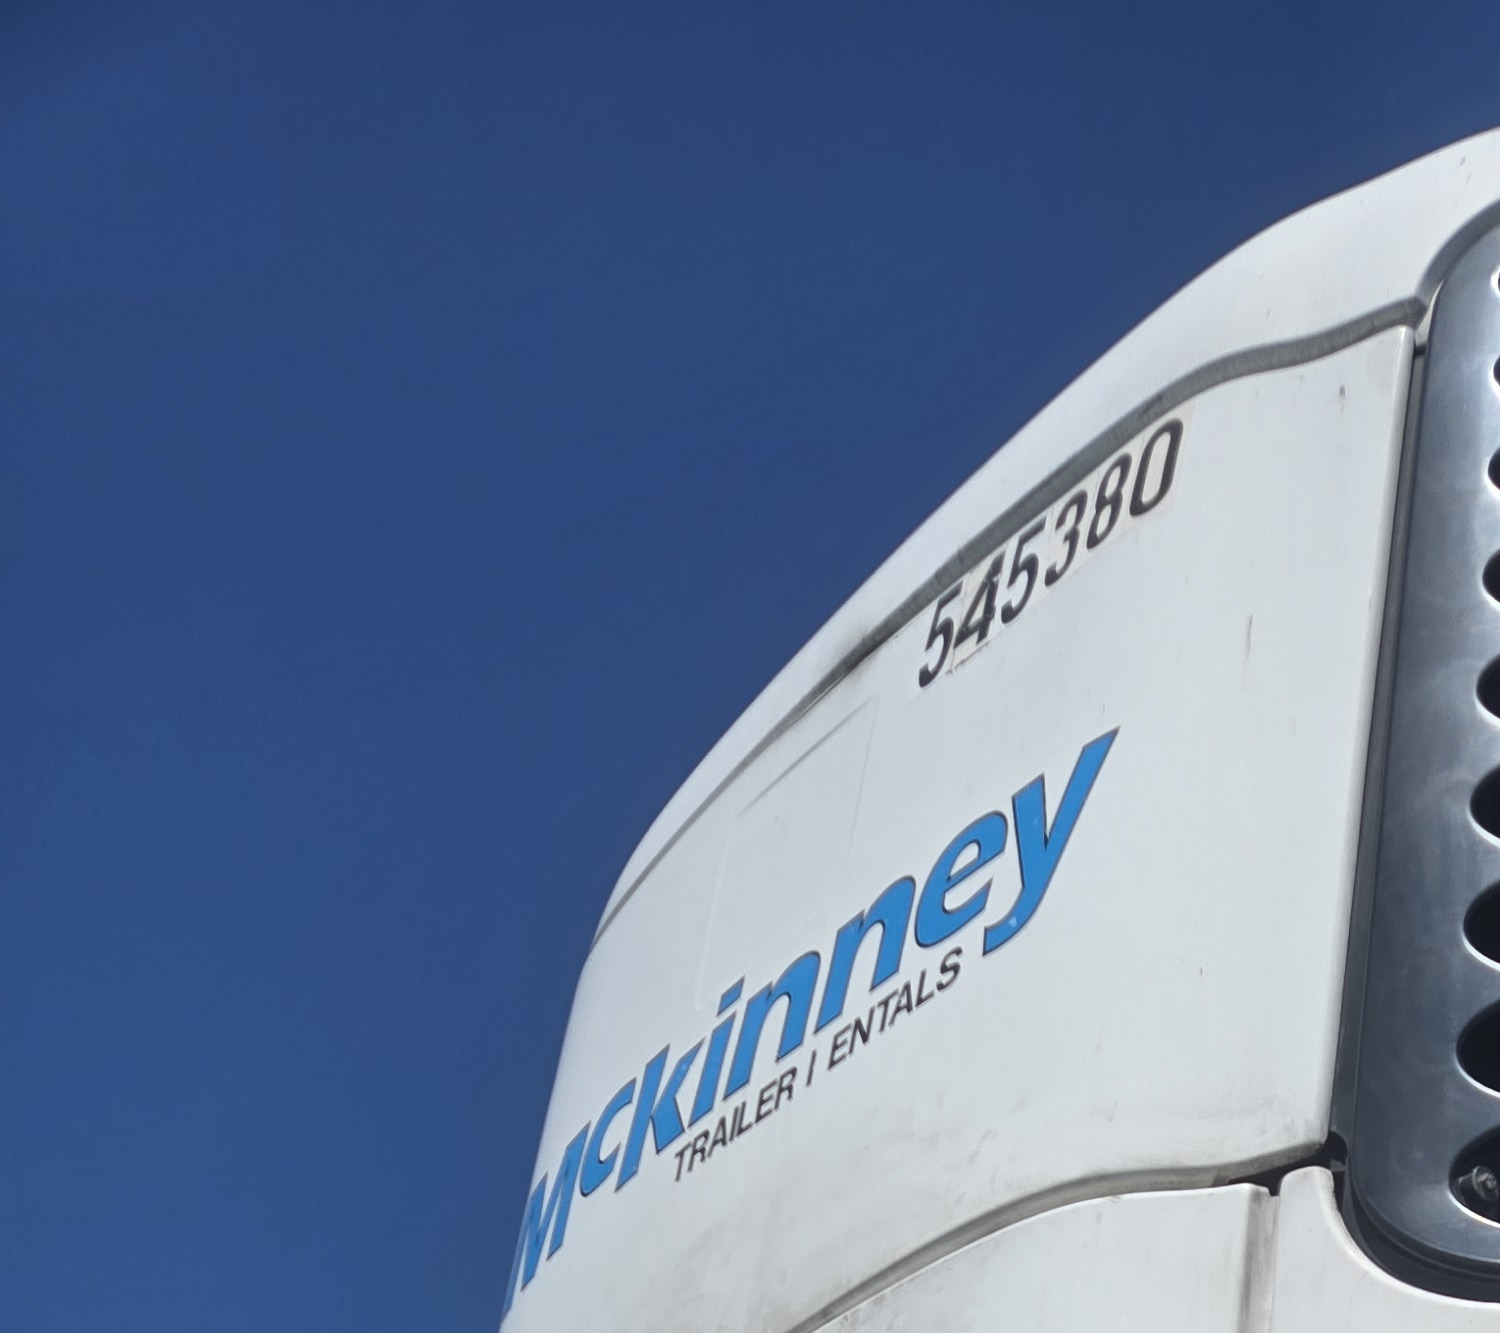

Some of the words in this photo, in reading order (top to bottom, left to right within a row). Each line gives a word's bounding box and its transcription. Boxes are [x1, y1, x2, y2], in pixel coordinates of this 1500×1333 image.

[916, 416, 1186, 690] 545380
[673, 1065, 798, 1184] TRAILER
[806, 945, 965, 1089] ENTALS
